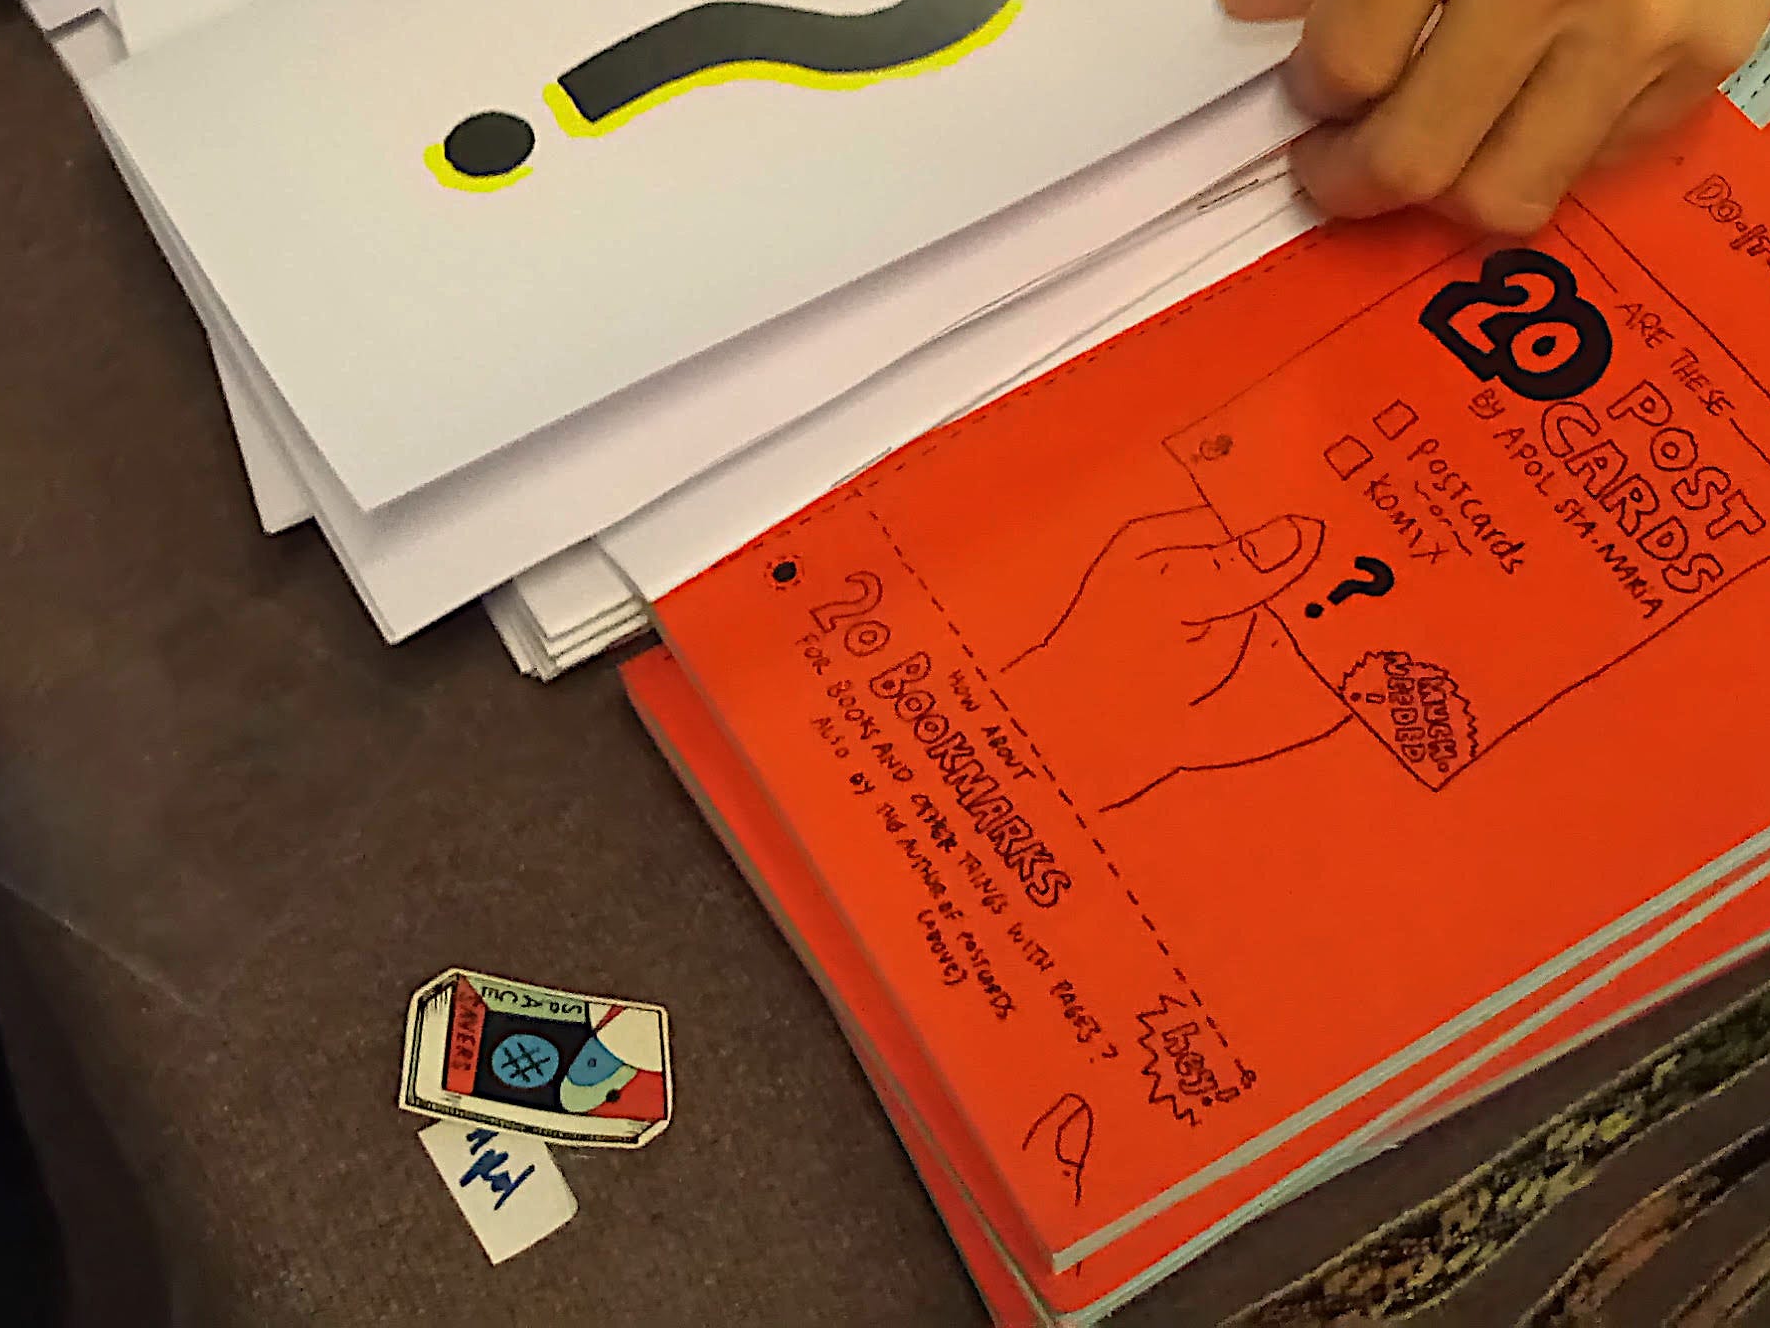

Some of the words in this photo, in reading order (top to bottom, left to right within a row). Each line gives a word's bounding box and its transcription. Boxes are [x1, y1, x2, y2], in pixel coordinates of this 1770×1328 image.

[1417, 246, 1615, 402] 20
[1613, 299, 1677, 352] ARE
[1669, 346, 1736, 417] THESE
[1539, 400, 1725, 596] CARDS
[1606, 379, 1768, 540] POST
[809, 570, 892, 657] 20
[869, 650, 1073, 909] BOOKMARKS
[871, 742, 915, 783] AND
